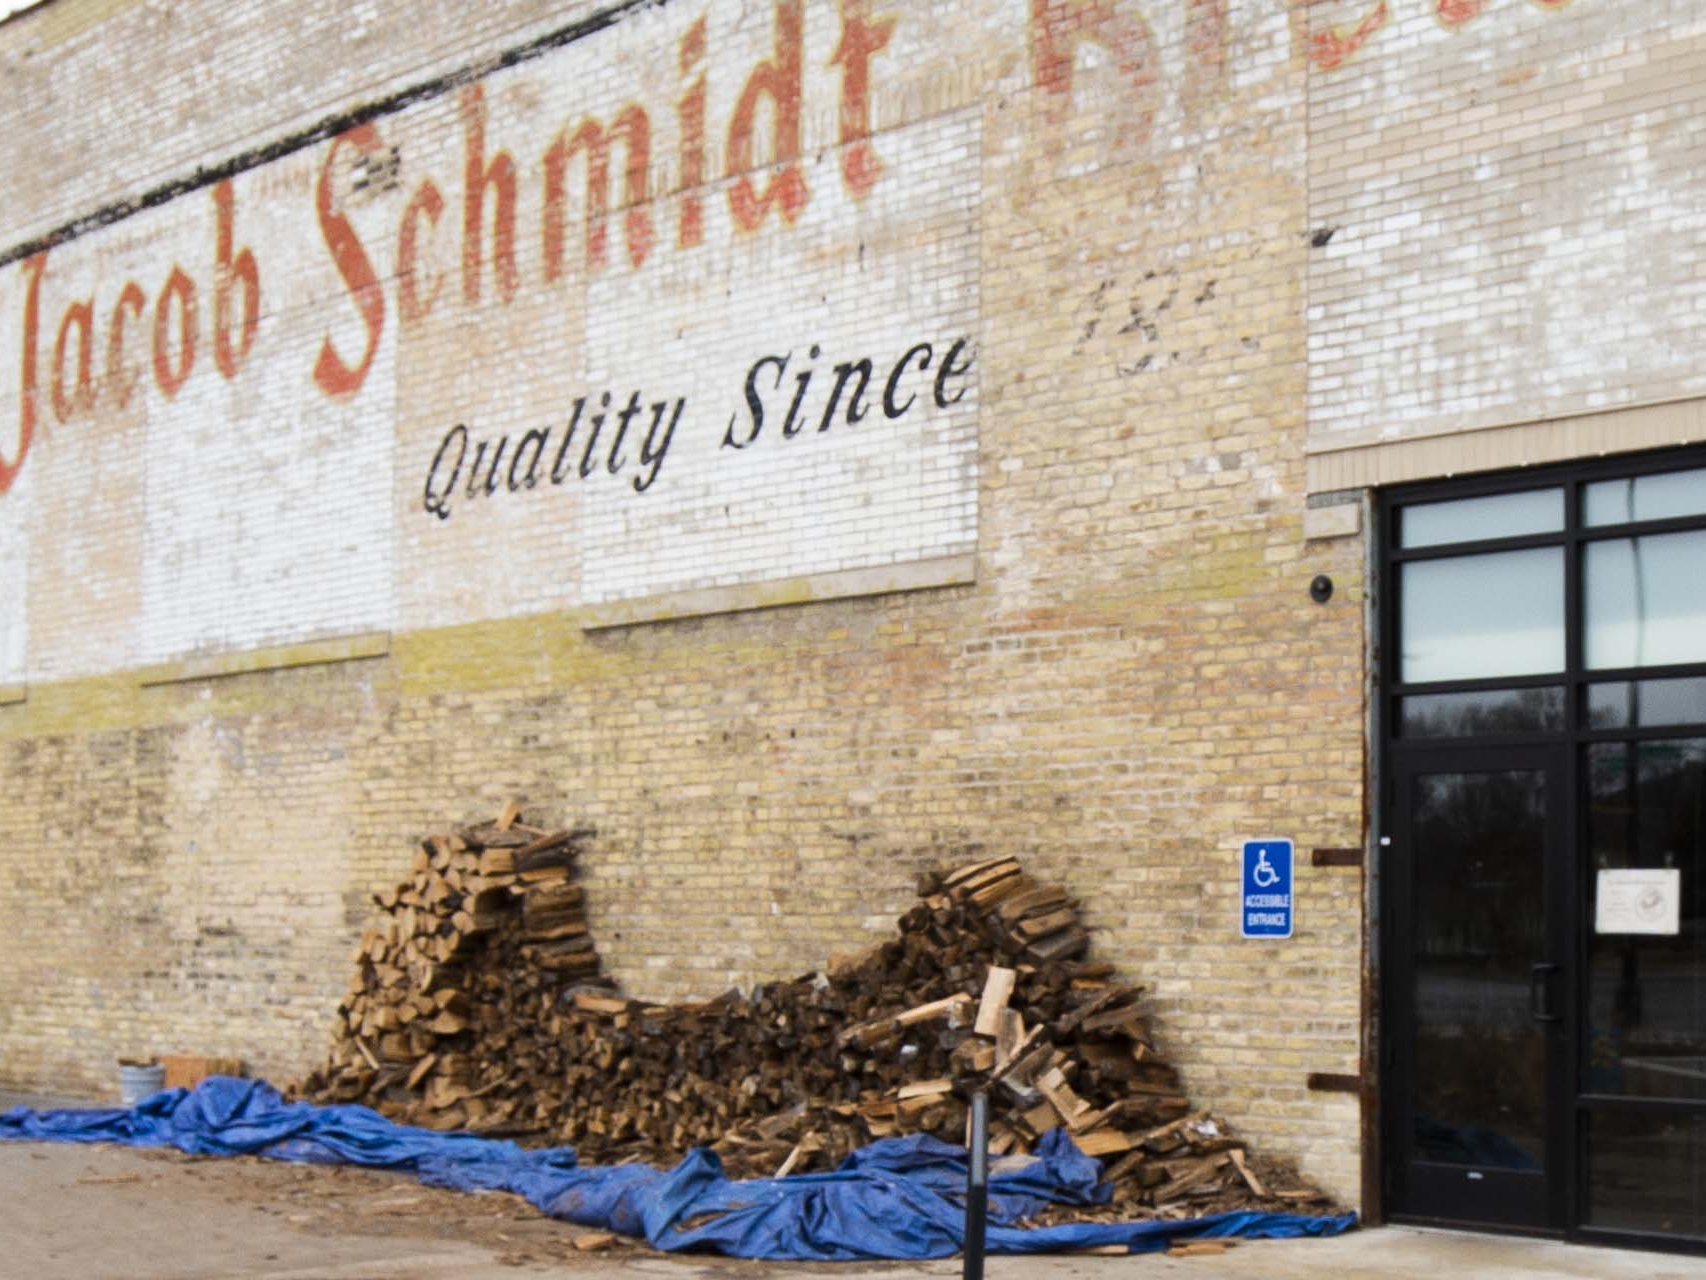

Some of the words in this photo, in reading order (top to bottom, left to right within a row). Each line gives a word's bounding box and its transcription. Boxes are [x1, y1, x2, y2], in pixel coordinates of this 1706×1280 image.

[423, 390, 686, 520] Quality
[720, 334, 981, 450] Since
[1245, 893, 1290, 908] ACCESSIBLE
[1247, 912, 1287, 926] ENTRANCE
